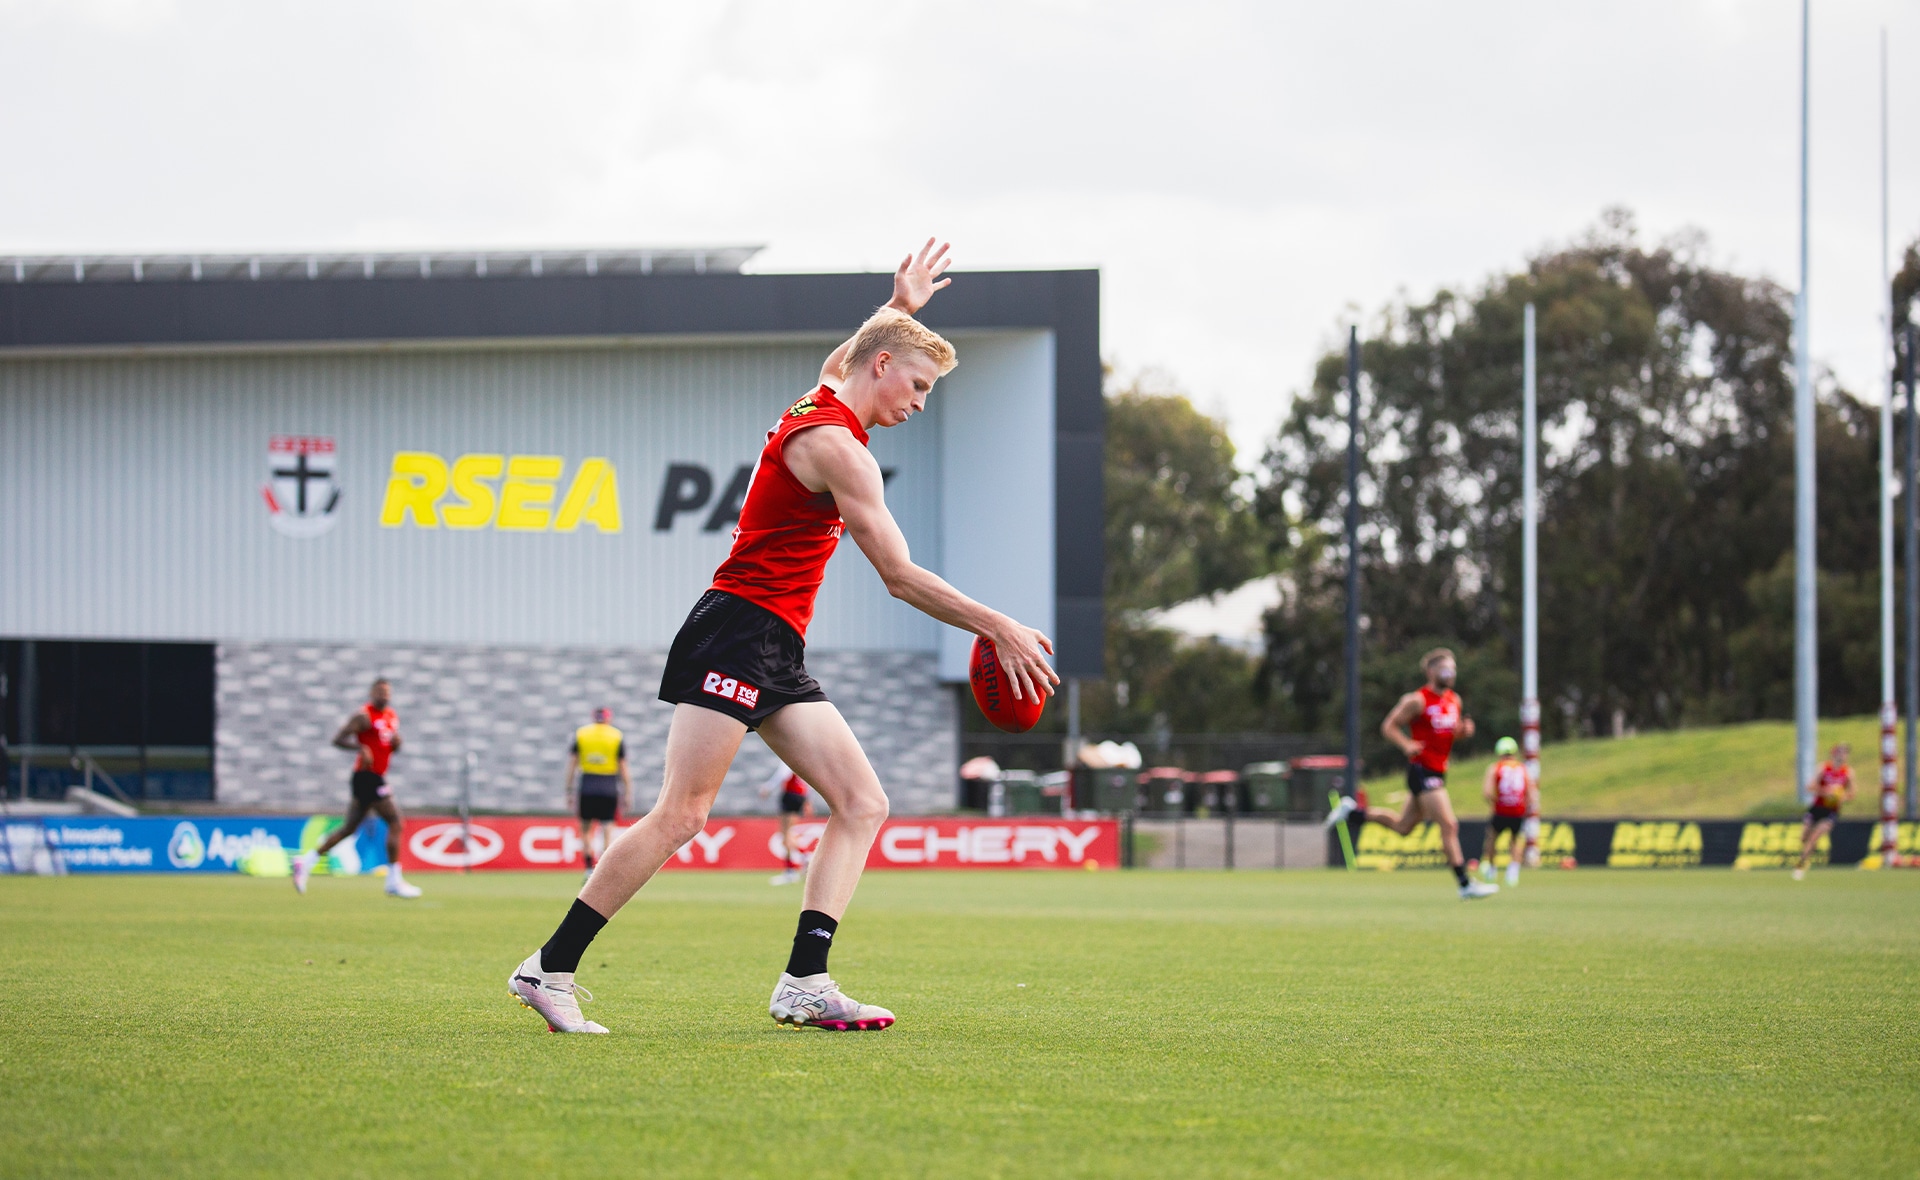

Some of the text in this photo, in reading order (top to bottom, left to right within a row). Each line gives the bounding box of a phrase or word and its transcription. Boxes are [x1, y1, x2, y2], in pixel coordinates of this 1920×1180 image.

[380, 452, 622, 533] RSEA
[738, 686, 759, 702] red
[519, 826, 736, 863] CHY
[881, 826, 1101, 863] CHERY
[1611, 821, 1703, 851] RSEA
